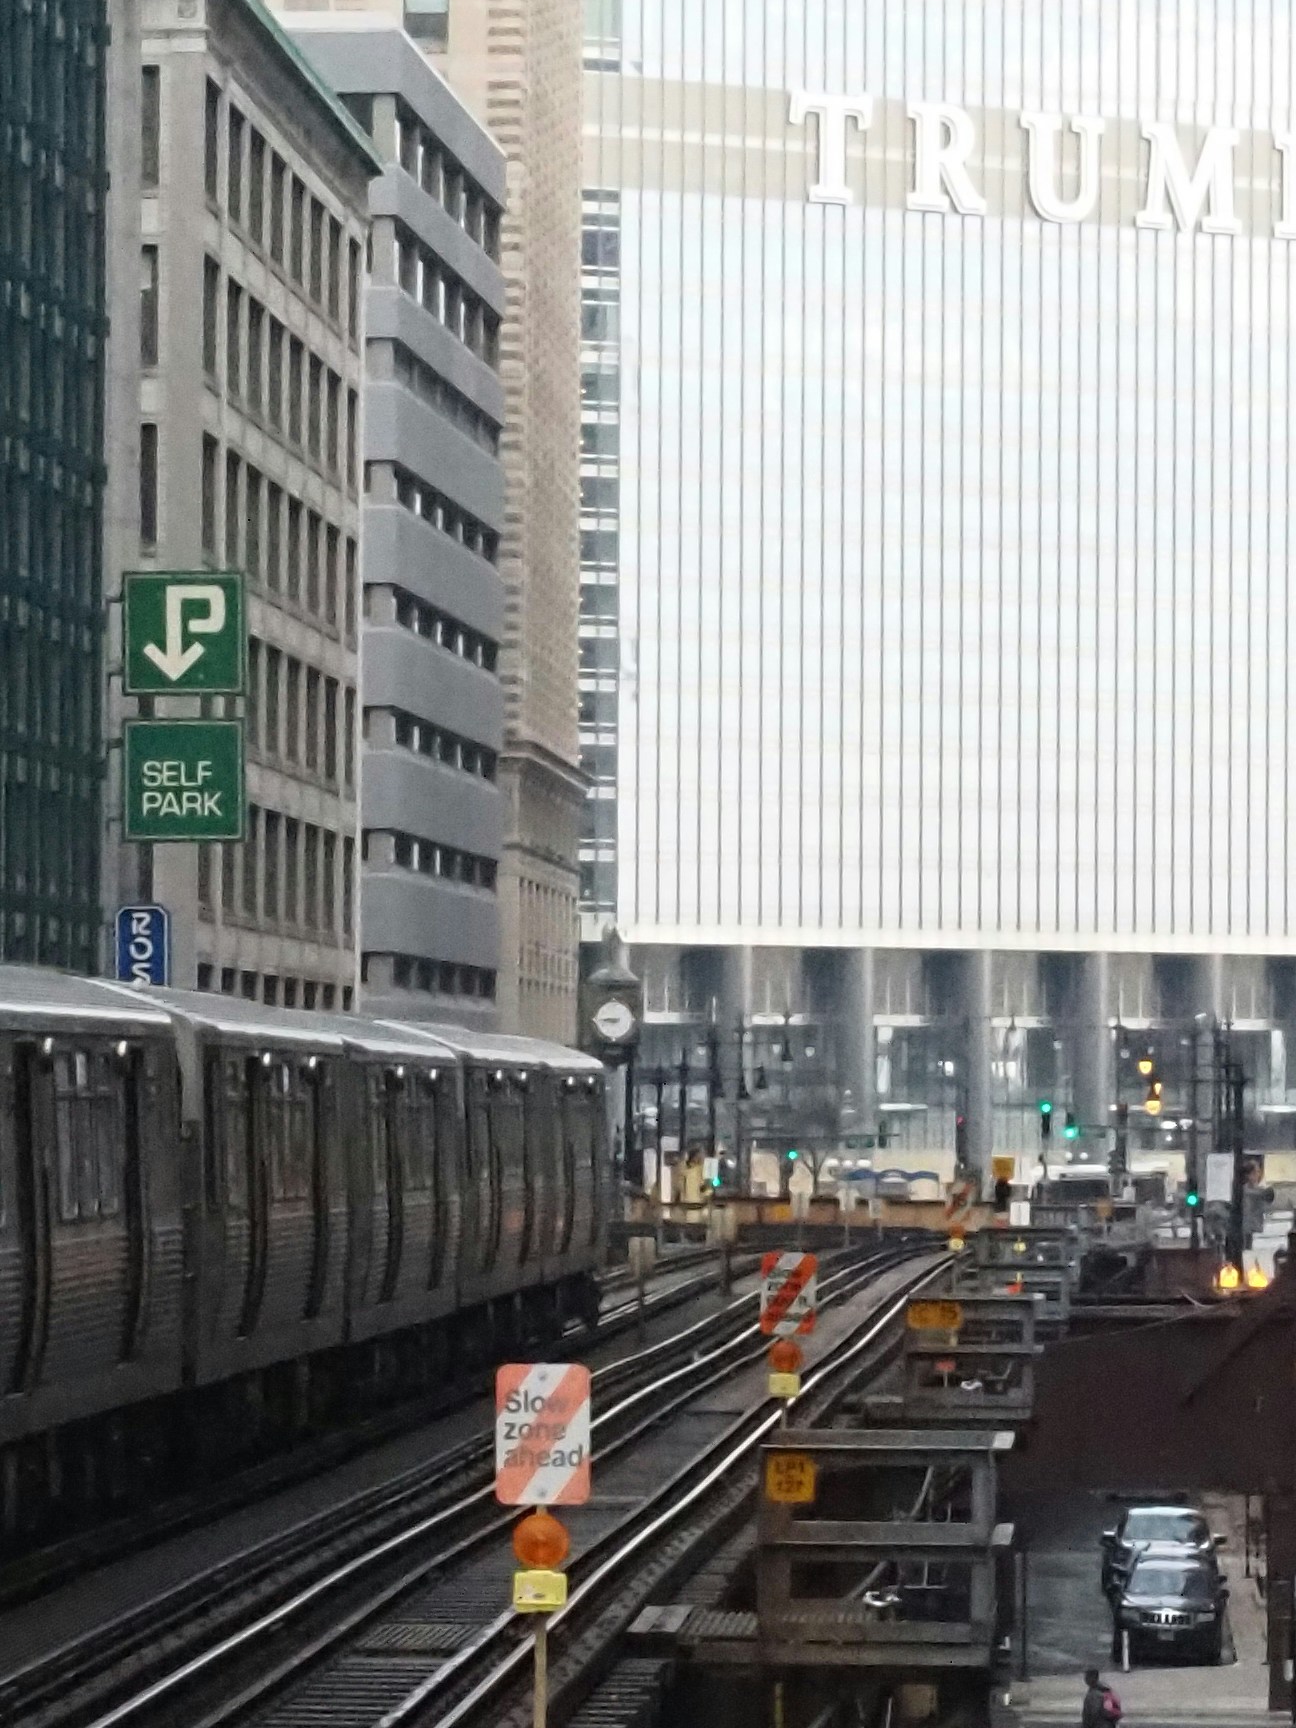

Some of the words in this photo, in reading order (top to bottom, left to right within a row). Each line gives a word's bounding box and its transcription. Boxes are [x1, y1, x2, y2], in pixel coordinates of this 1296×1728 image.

[142, 760, 212, 787] SELF
[142, 791, 222, 816] PARK
[504, 1389, 567, 1414] Slow
[503, 1421, 566, 1441] zone
[503, 1443, 584, 1468] ahead
